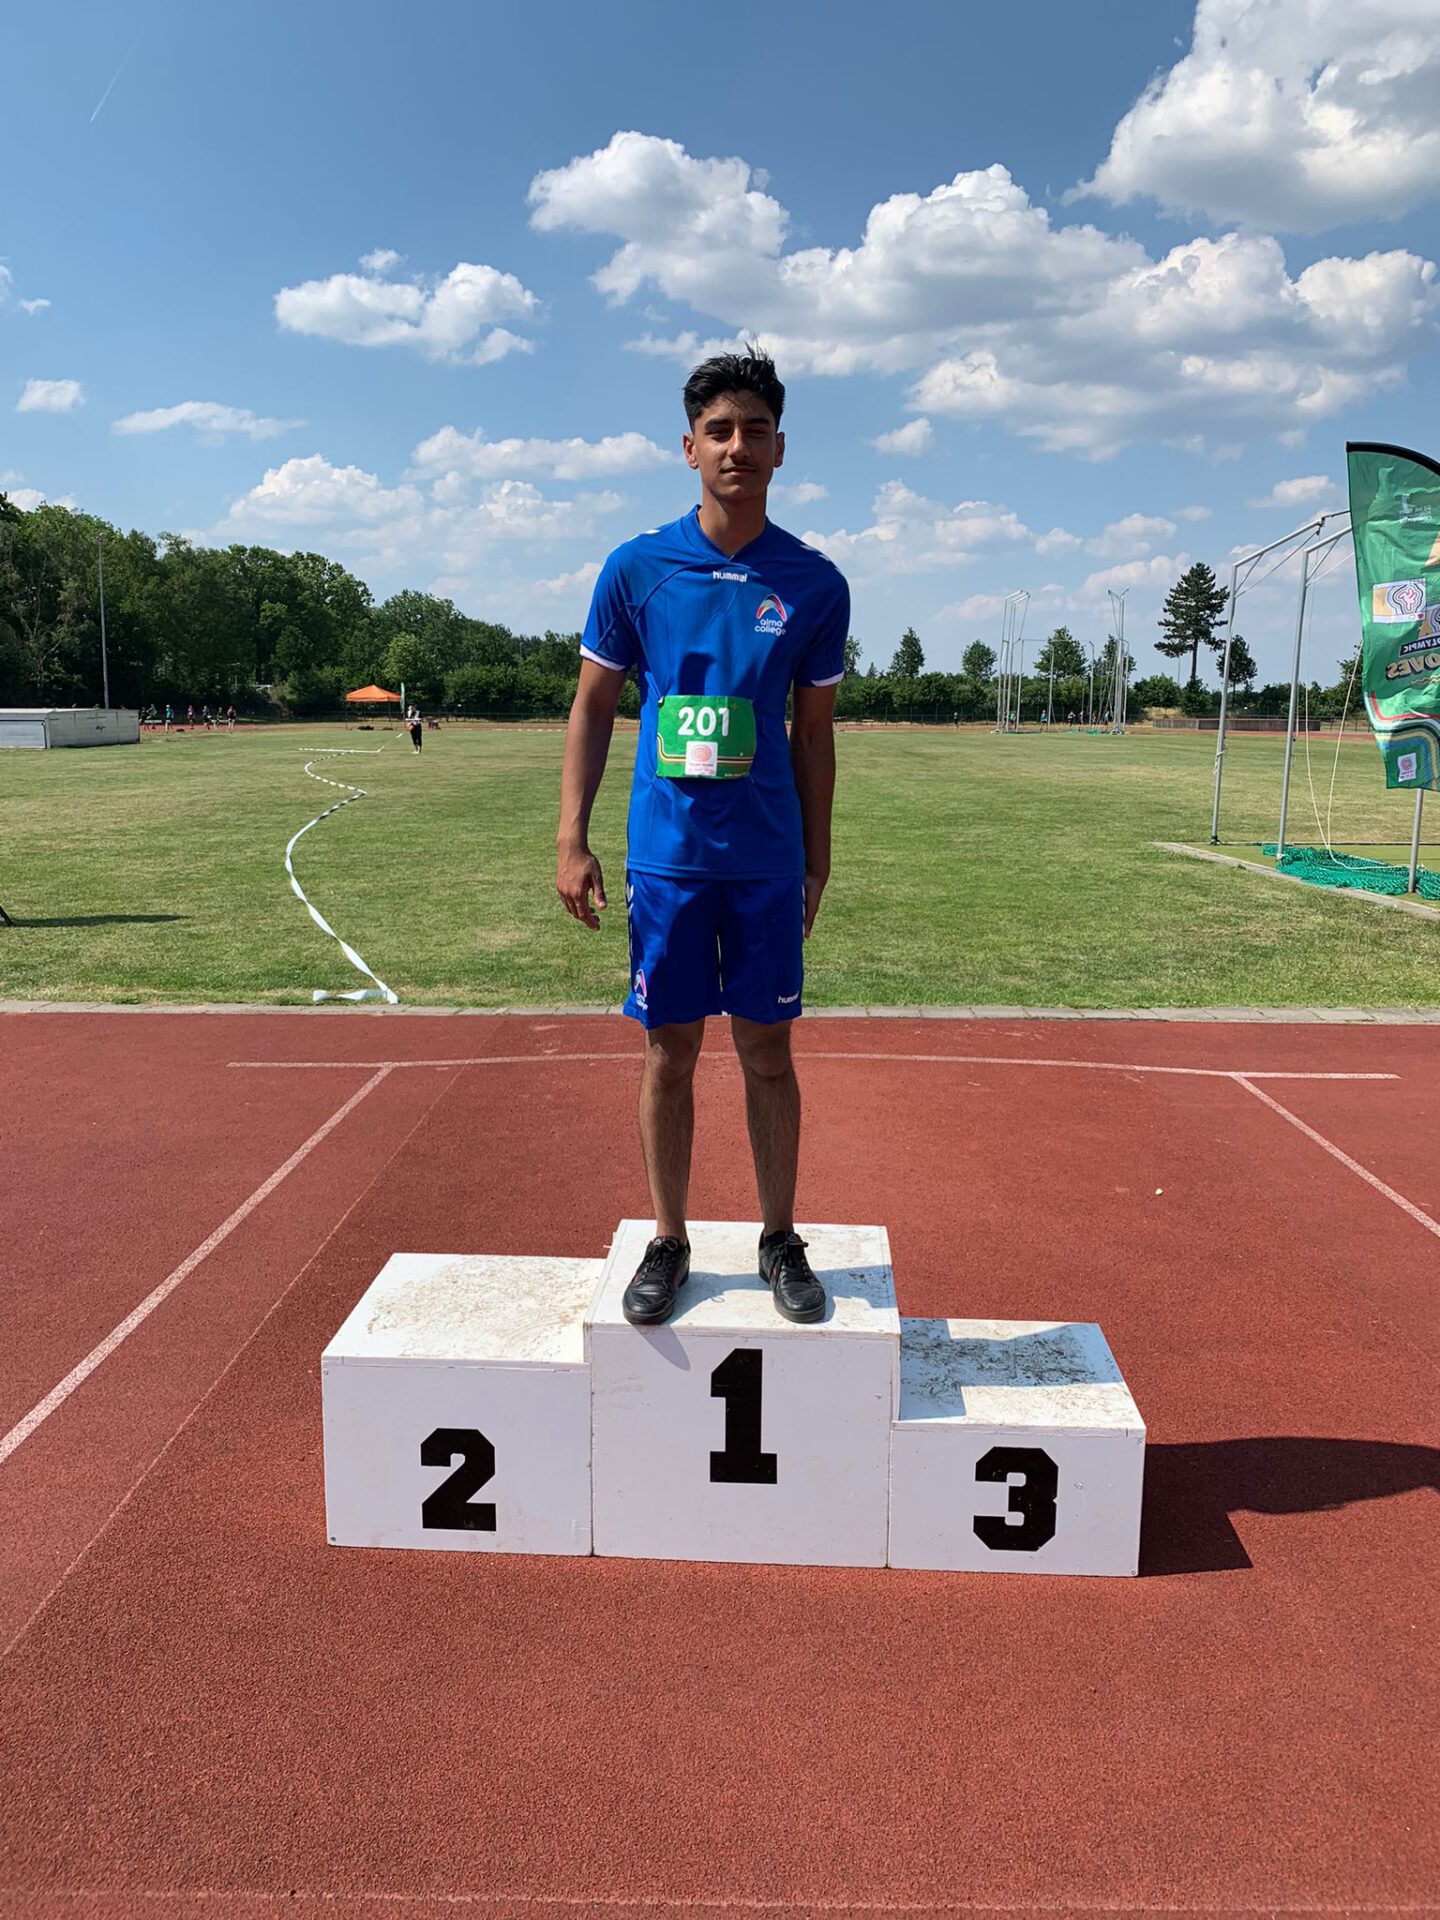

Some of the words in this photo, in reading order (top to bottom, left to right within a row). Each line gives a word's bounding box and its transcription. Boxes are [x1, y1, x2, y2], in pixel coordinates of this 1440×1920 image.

[712, 571, 748, 583] hummel
[754, 625, 786, 636] college
[760, 618, 783, 627] alma
[677, 706, 729, 736] 201
[710, 1349, 777, 1484] 1
[421, 1428, 496, 1531] 2
[973, 1447, 1058, 1551] 3
